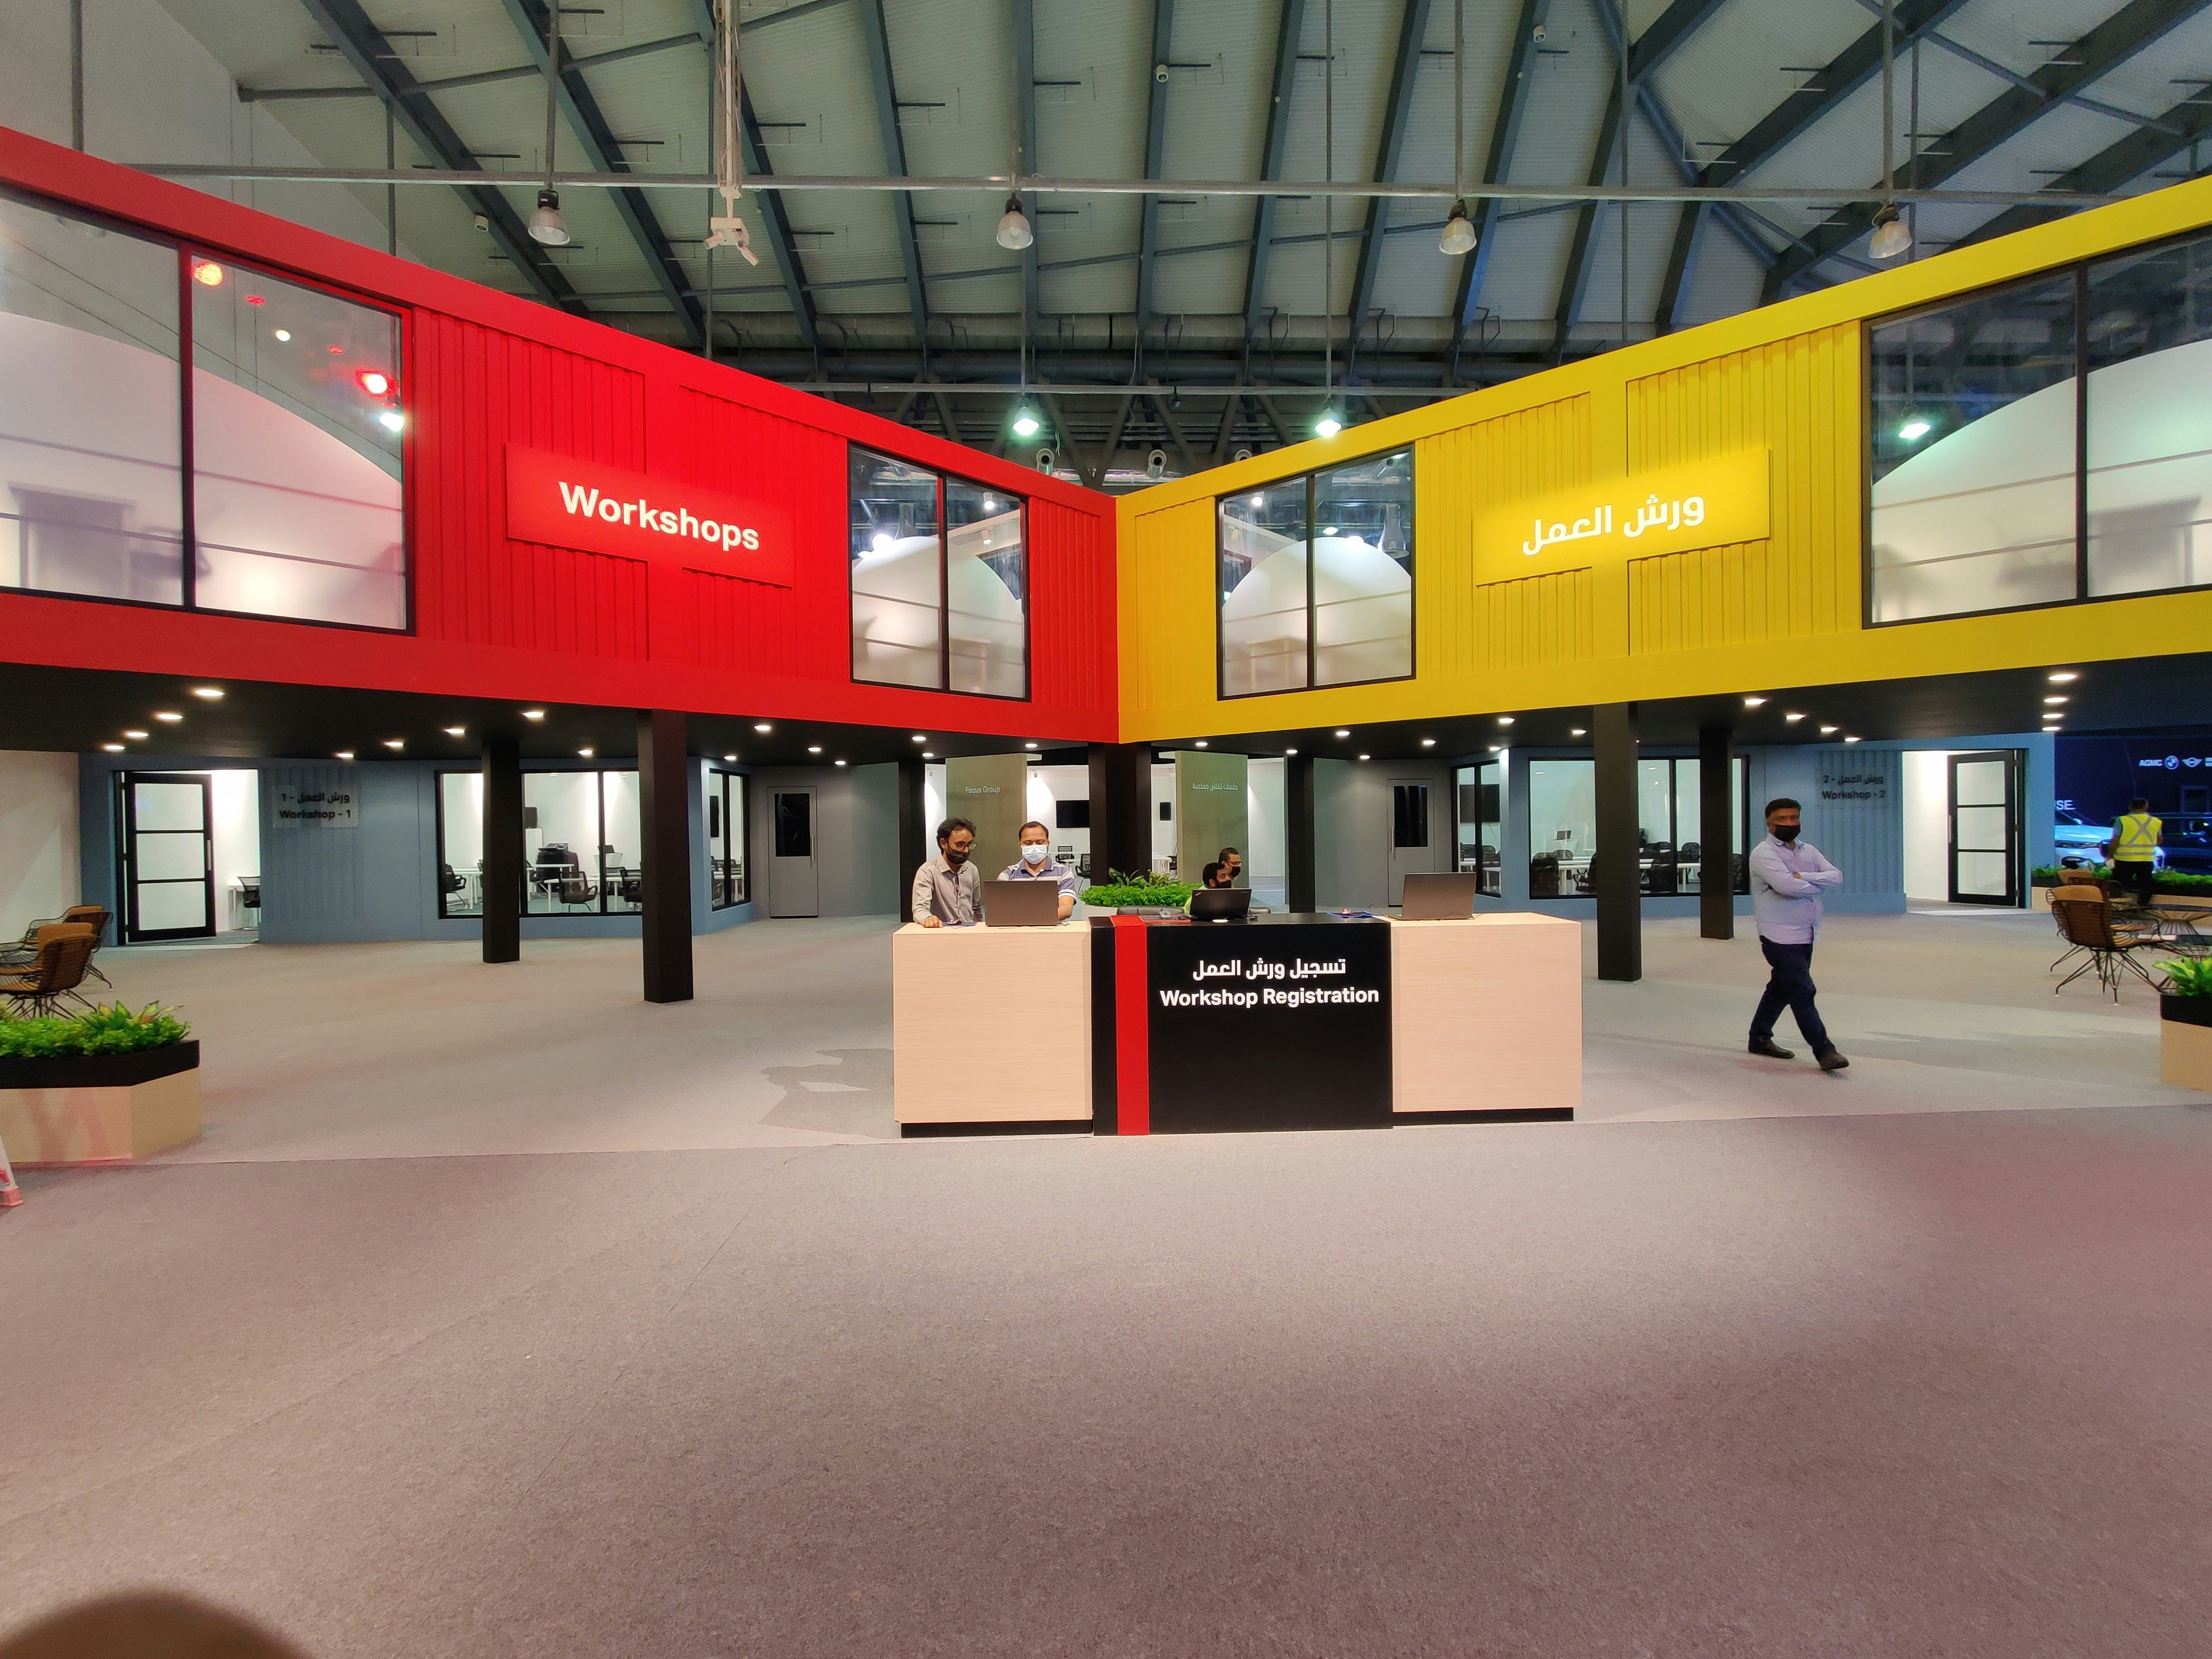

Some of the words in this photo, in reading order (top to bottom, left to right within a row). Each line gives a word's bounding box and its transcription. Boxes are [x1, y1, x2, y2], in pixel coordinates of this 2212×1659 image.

[559, 481, 759, 551] Workshops
[1623, 493, 1705, 538] ورش
[1522, 504, 1612, 556] العمل
[1838, 775, 1862, 785] العمل
[1864, 775, 1884, 784] ورش
[983, 786, 1000, 794] Group
[1822, 790, 1871, 800] Workshop
[281, 793, 286, 801] 1
[297, 792, 325, 804] العمل
[327, 791, 350, 804] ورش
[2054, 800, 2076, 810] SE
[279, 810, 335, 820] Workshop
[346, 810, 351, 818] 1
[1192, 959, 1241, 981] العمل
[1245, 957, 1285, 980] ورش
[1289, 958, 1346, 979] تسجيل
[1160, 989, 1258, 1008] Workshop
[1263, 987, 1379, 1008] Registration
